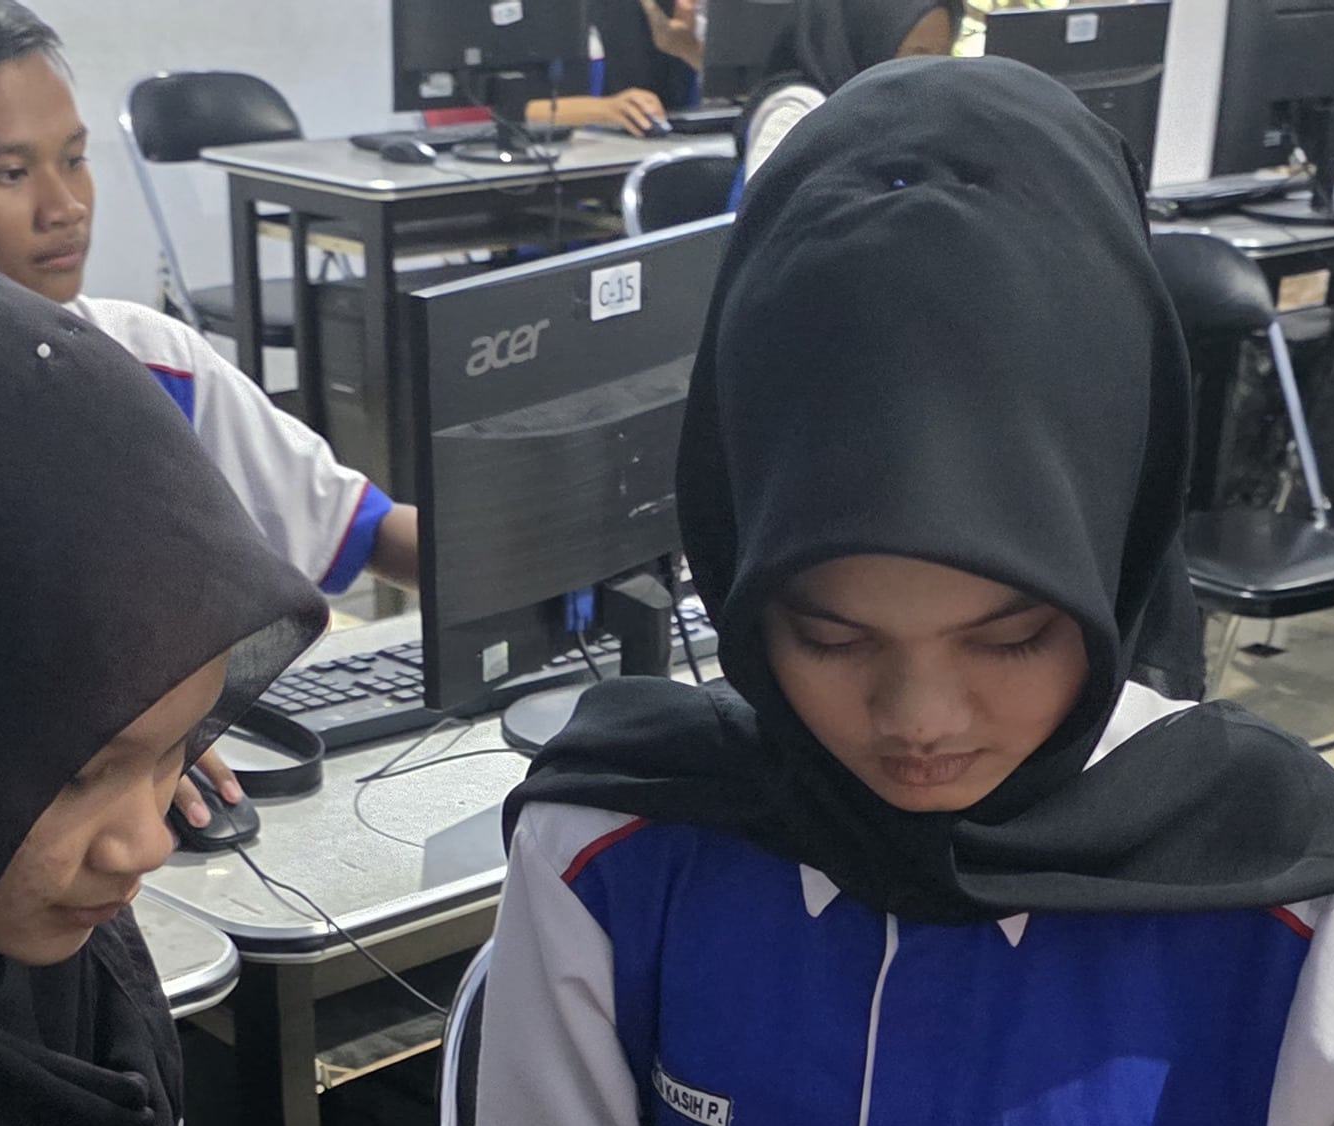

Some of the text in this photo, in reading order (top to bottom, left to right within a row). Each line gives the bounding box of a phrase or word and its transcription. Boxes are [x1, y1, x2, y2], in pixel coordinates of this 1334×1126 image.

[598, 275, 635, 308] C-15
[465, 318, 550, 376] acer
[706, 1101, 723, 1125] P.
